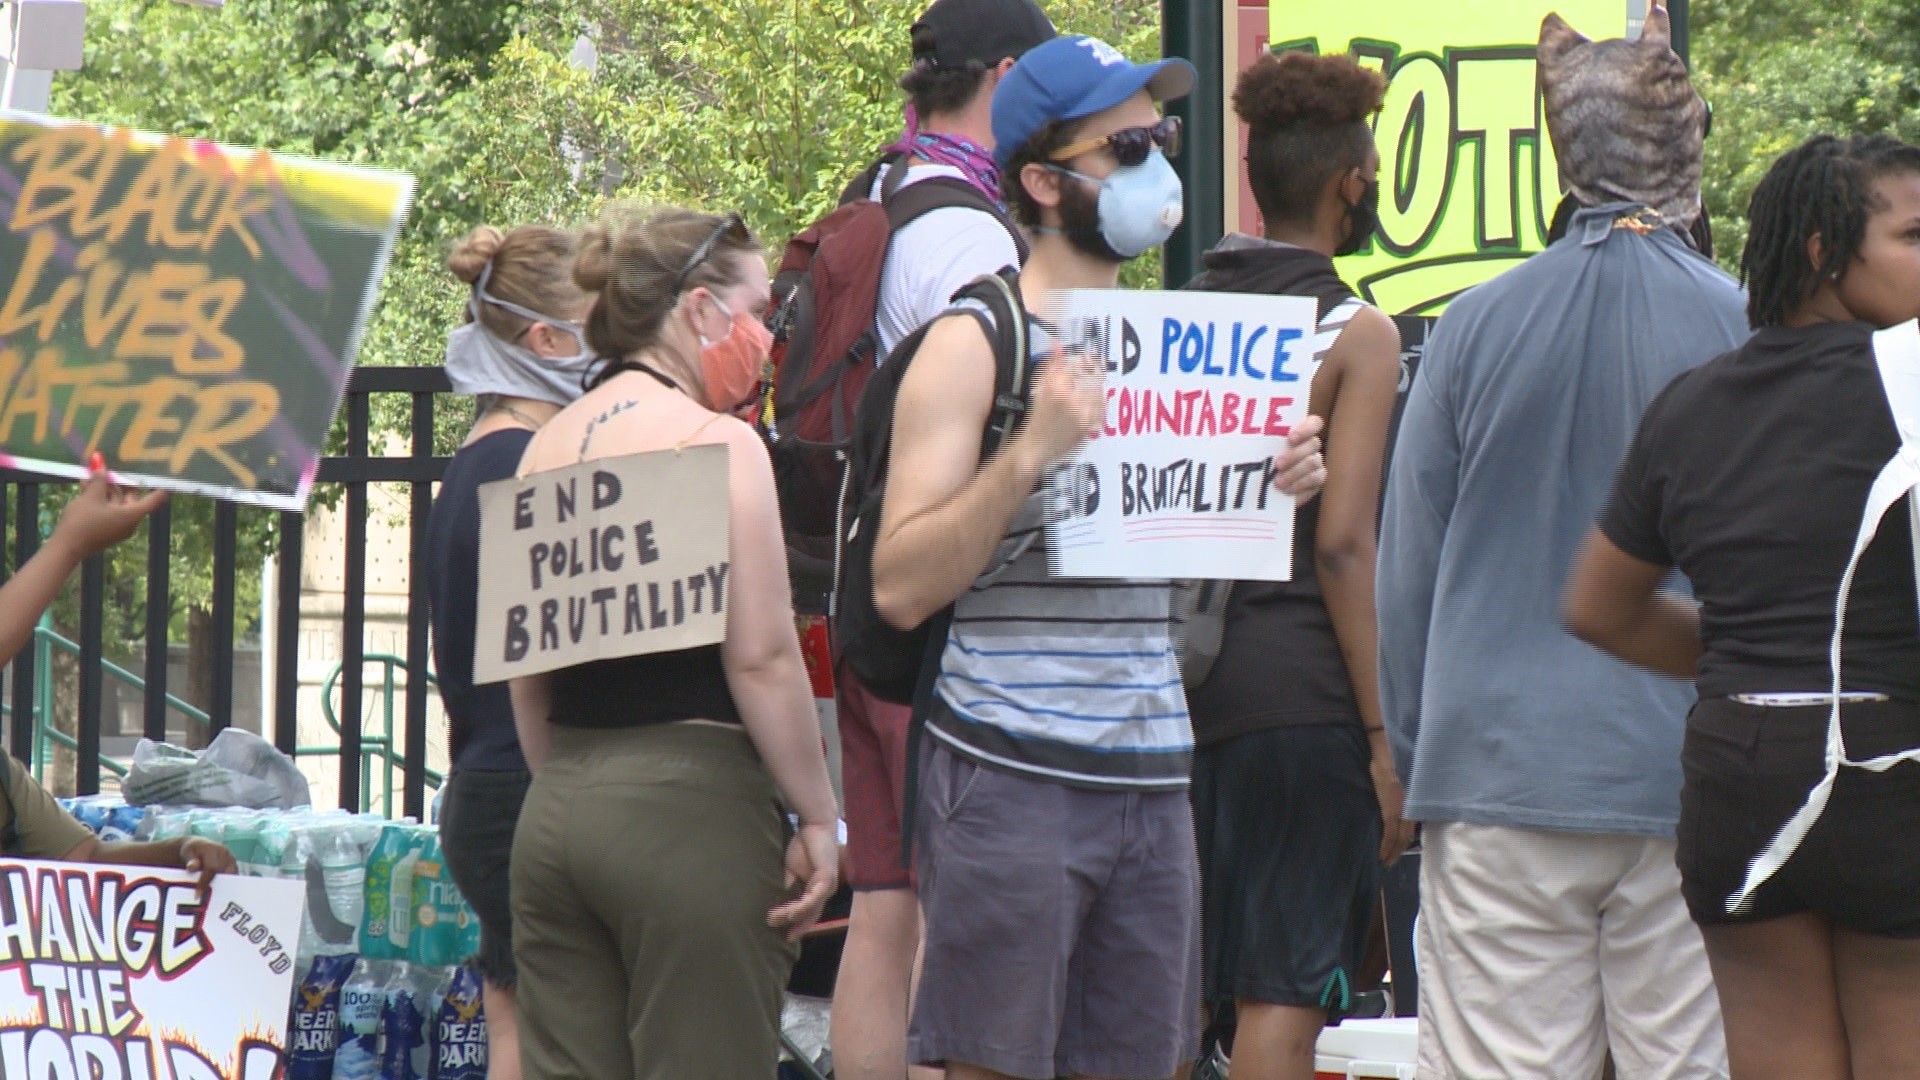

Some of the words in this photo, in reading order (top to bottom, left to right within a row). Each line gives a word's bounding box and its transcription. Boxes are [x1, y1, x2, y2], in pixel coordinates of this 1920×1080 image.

[1268, 38, 1568, 257] OT
[8, 125, 268, 262] BLACK
[1160, 316, 1303, 382] POLICE
[1088, 386, 1295, 440] COUNTABLE
[513, 470, 623, 531] END
[1120, 456, 1279, 517] BRUTALITY
[529, 520, 660, 591] POLICE
[504, 561, 730, 663] BRUTALITY
[0, 867, 210, 977] HANGE
[219, 901, 292, 976] FLOYD
[28, 961, 138, 1038] THE
[295, 1010, 336, 1030] EER
[294, 1029, 334, 1052] ARK
